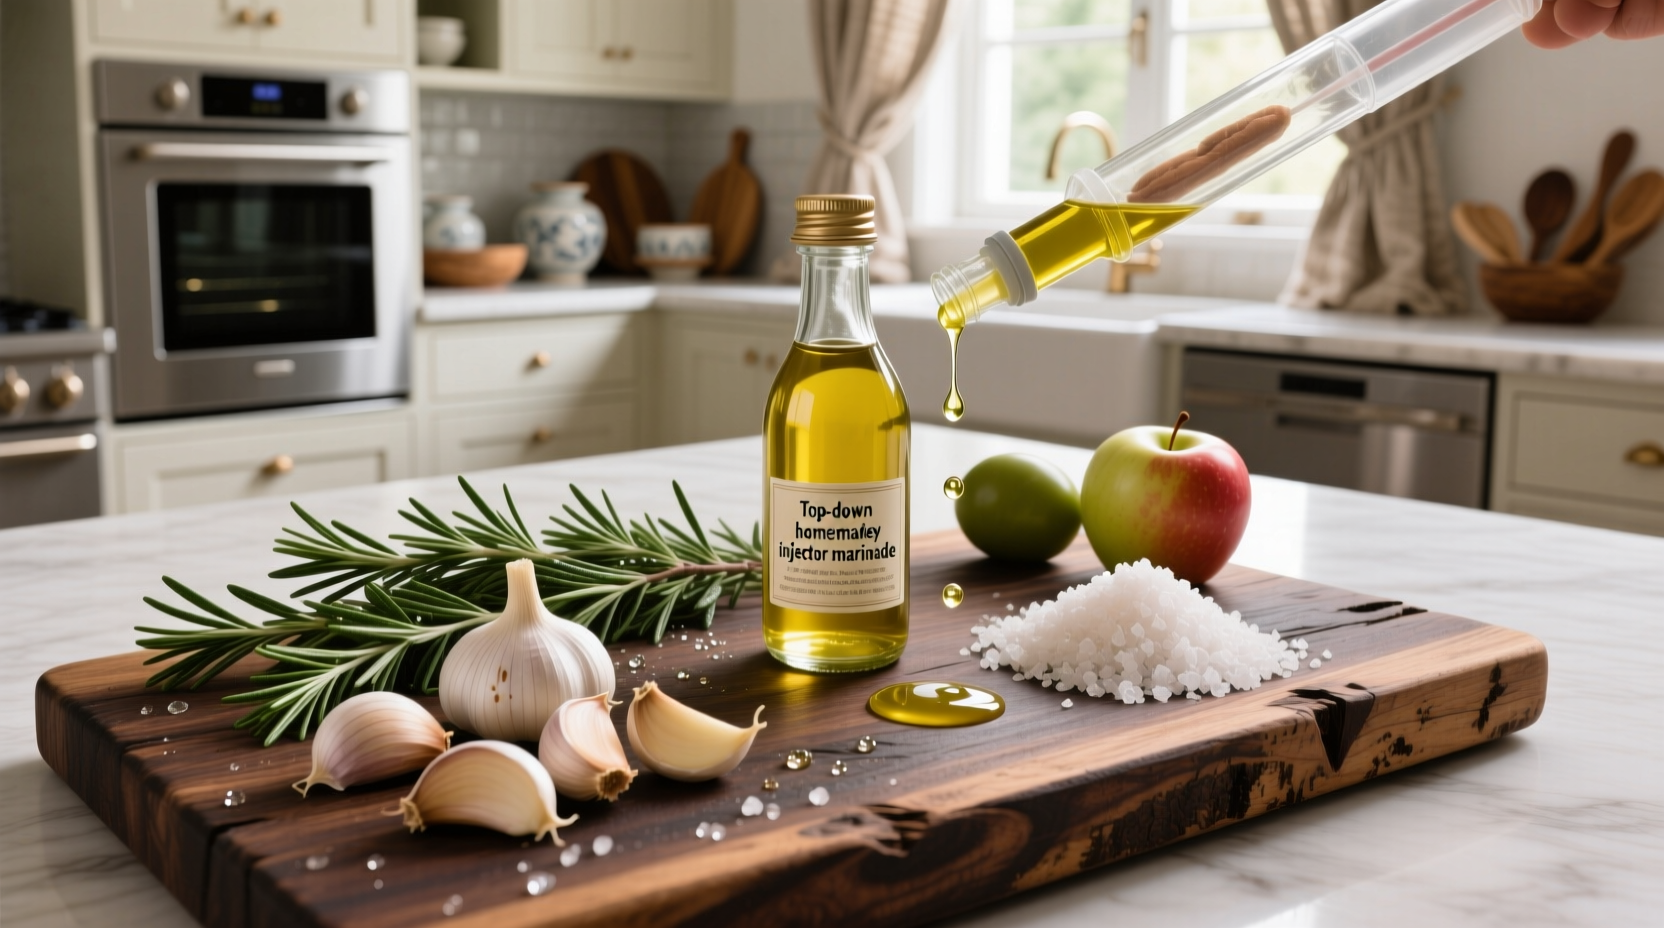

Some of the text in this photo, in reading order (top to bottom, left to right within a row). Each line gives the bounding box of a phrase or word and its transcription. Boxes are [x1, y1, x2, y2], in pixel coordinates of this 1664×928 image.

[800, 500, 872, 522] Top-down
[779, 542, 896, 562] injector marinade
